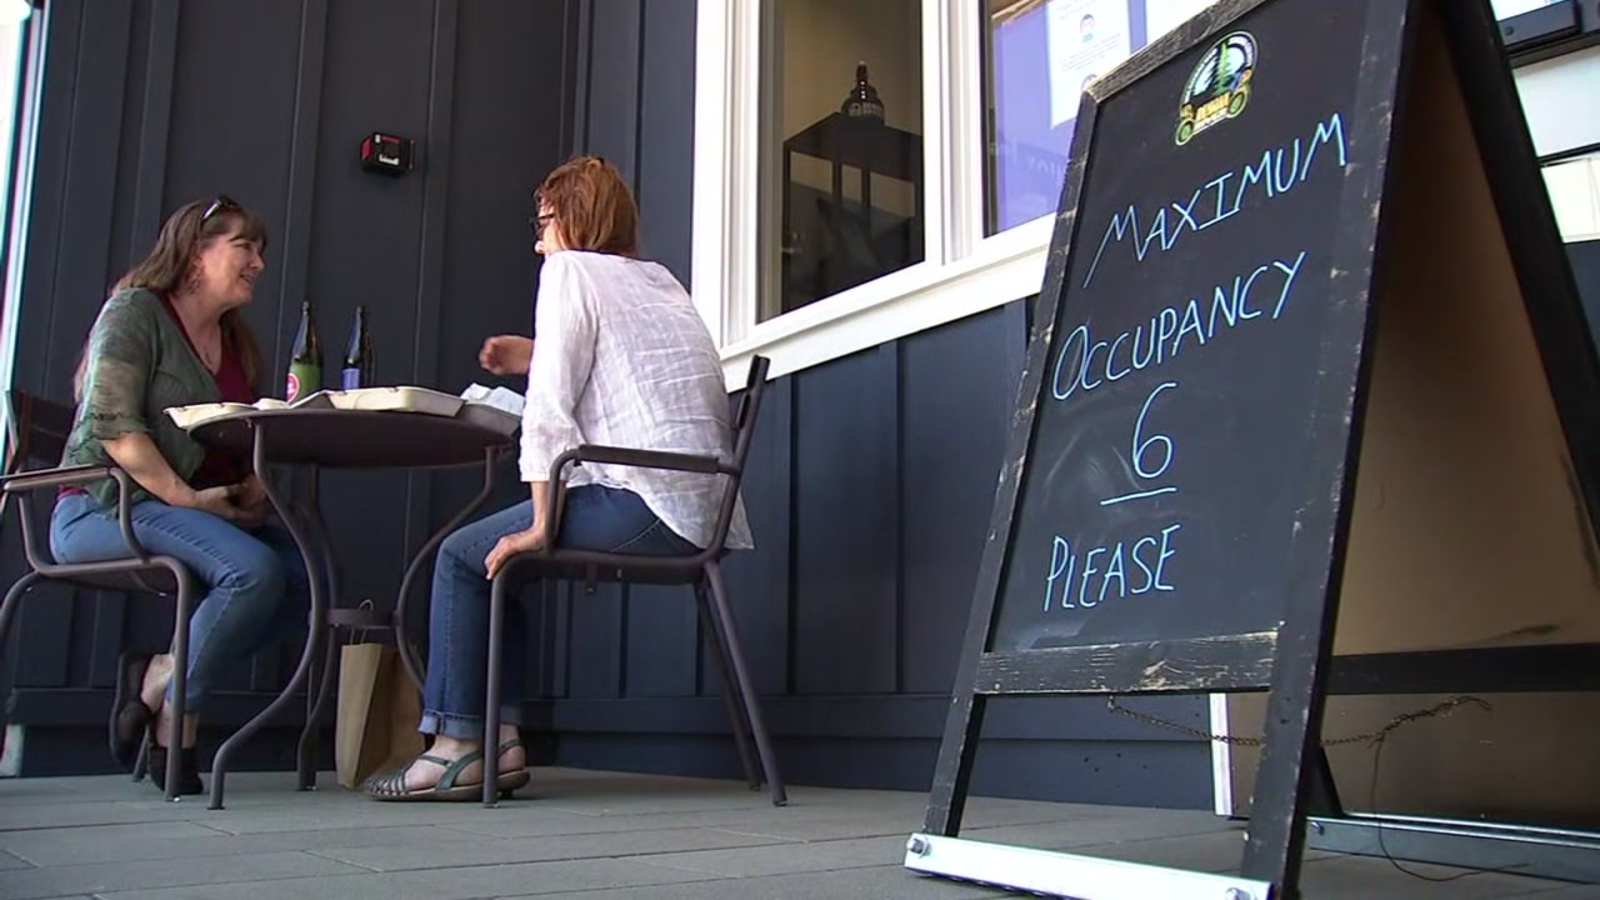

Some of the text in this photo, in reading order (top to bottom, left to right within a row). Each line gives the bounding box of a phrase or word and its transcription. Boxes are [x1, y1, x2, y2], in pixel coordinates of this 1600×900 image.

[1083, 113, 1347, 288] MAXIMUM
[1052, 251, 1306, 400] OCCUPANCY
[1132, 382, 1177, 478] 6
[1044, 524, 1181, 612] PLEASE
